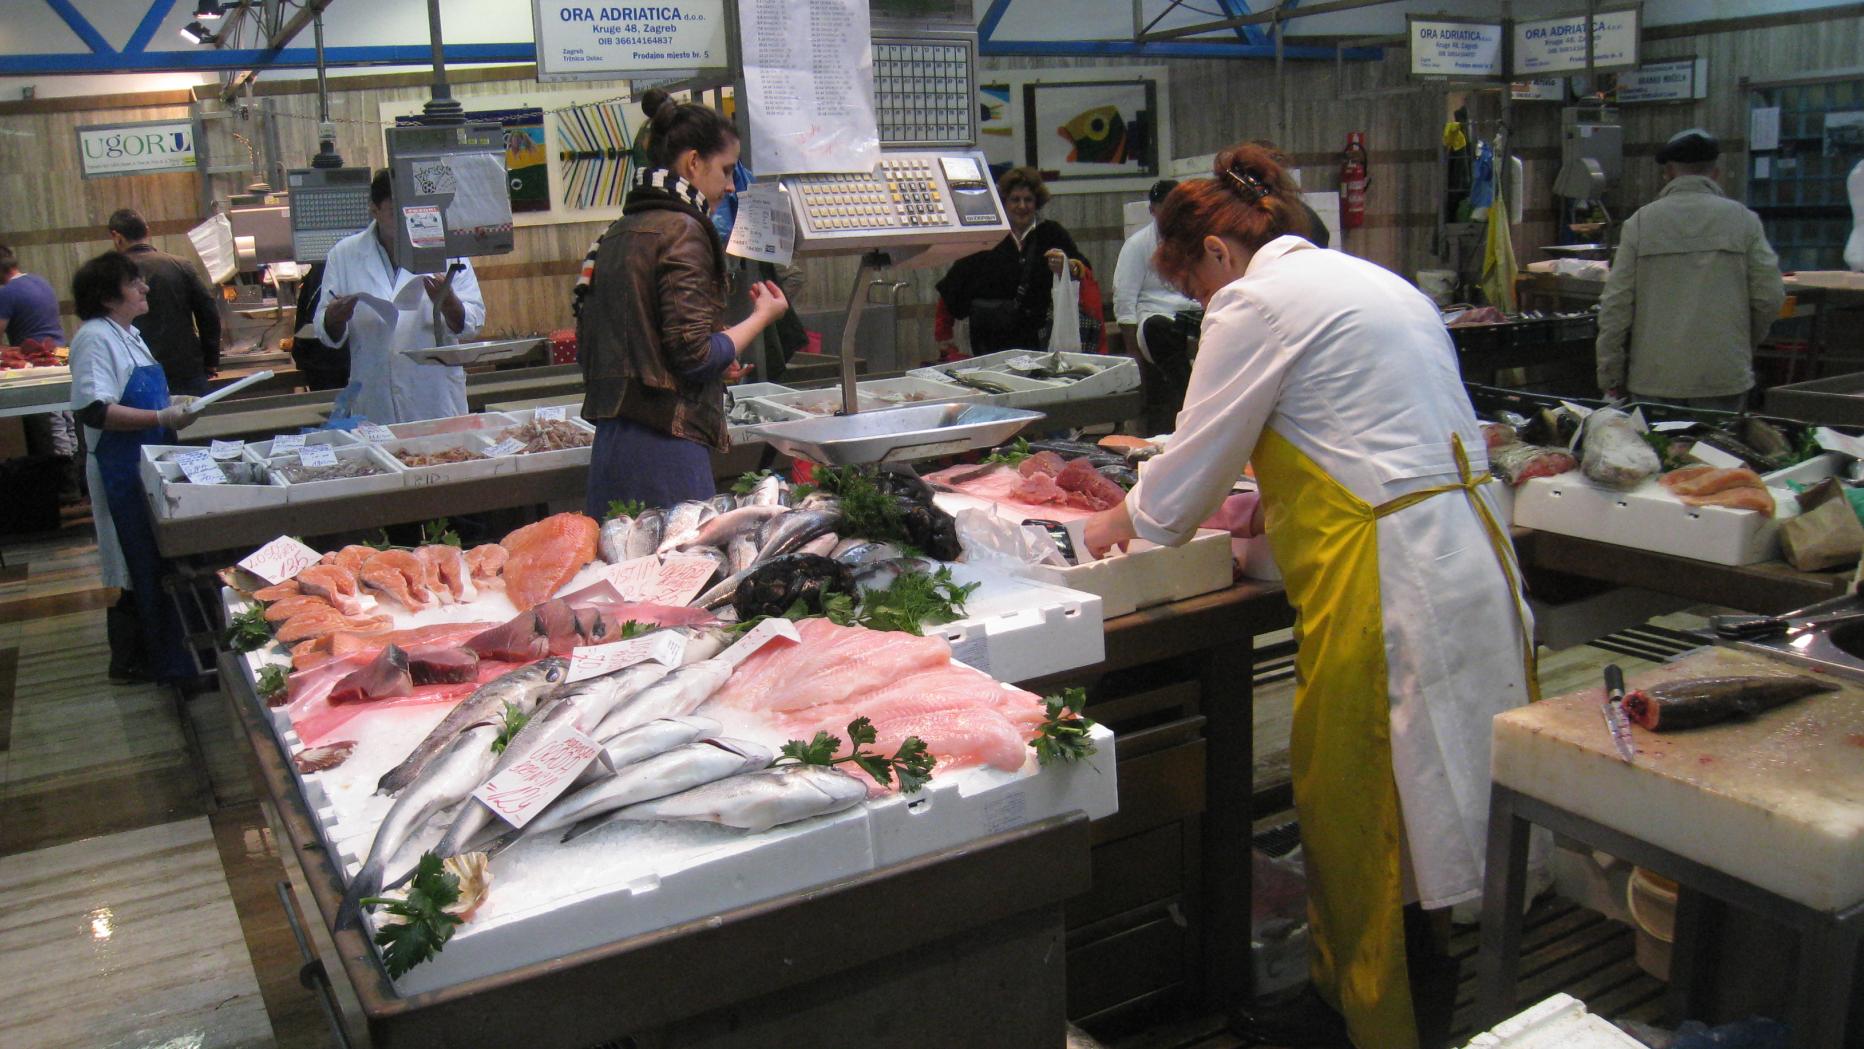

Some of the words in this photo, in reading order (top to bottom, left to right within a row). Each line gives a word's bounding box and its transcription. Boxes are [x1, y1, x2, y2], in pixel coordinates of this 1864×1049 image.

[560, 8, 594, 21] ORA
[600, 8, 681, 21] ADRIATICA
[684, 13, 706, 21] d.o.o.
[592, 24, 621, 34] Kruge
[624, 24, 640, 34] 48,
[643, 24, 677, 34] Zagreb
[1420, 28, 1437, 39] ORA
[1440, 29, 1481, 41] ADRIATICA
[1525, 29, 1547, 39] ORA
[1550, 22, 1606, 37] ADRIATCA
[598, 37, 613, 45] OIB
[633, 51, 665, 60] Prodajno
[667, 51, 690, 60] mjesto
[692, 51, 702, 59] br.
